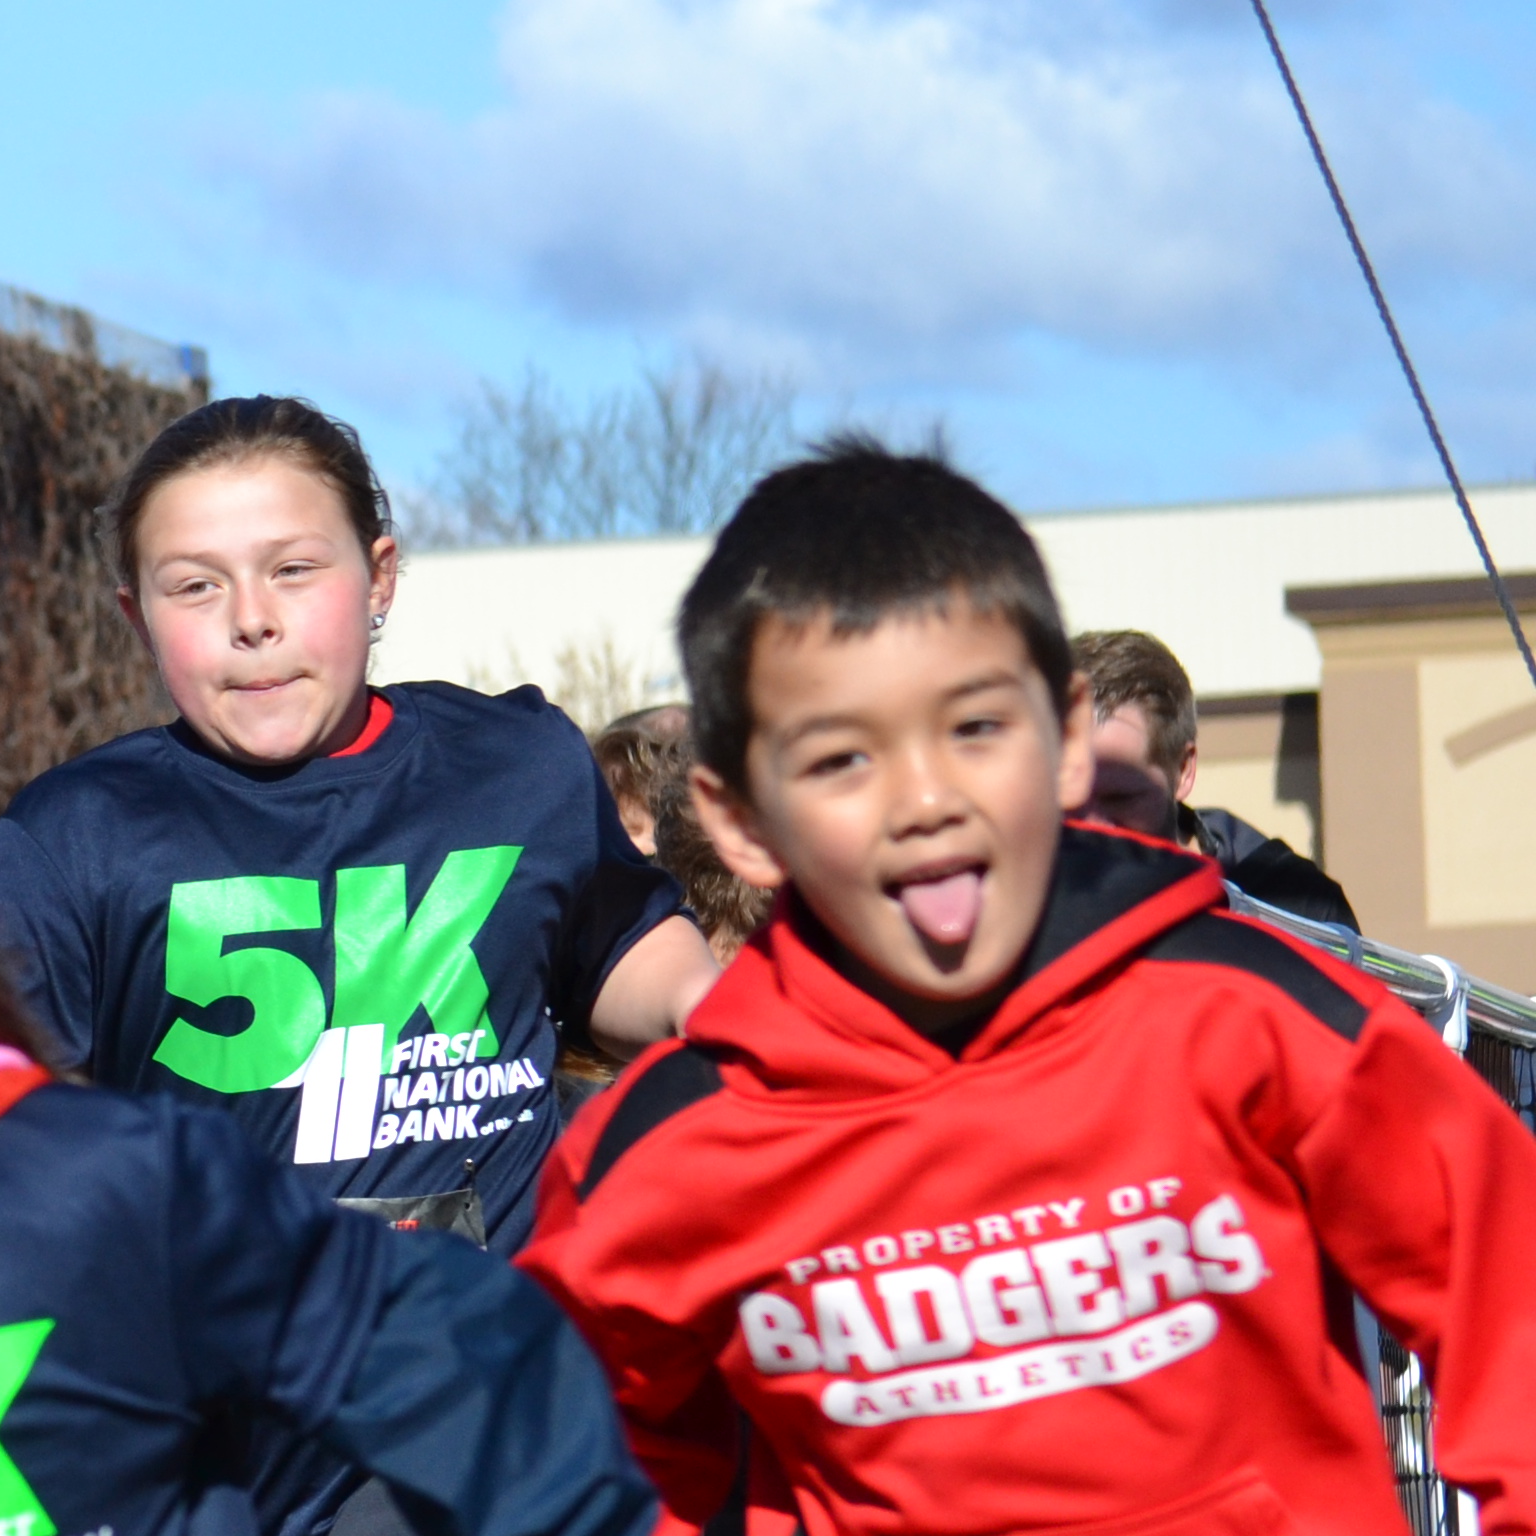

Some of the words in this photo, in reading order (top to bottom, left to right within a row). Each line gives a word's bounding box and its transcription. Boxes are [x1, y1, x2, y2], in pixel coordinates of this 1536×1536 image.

[153, 845, 525, 1094] 5K
[382, 1058, 545, 1111] NATIONAL
[389, 1029, 486, 1074] FIRST
[372, 1104, 481, 1149] BANK
[785, 1197, 1086, 1284] PROPERTY
[1108, 1177, 1182, 1218] OF
[738, 1193, 1265, 1375] BADGERS
[851, 1319, 1195, 1417] ATHLETICS
